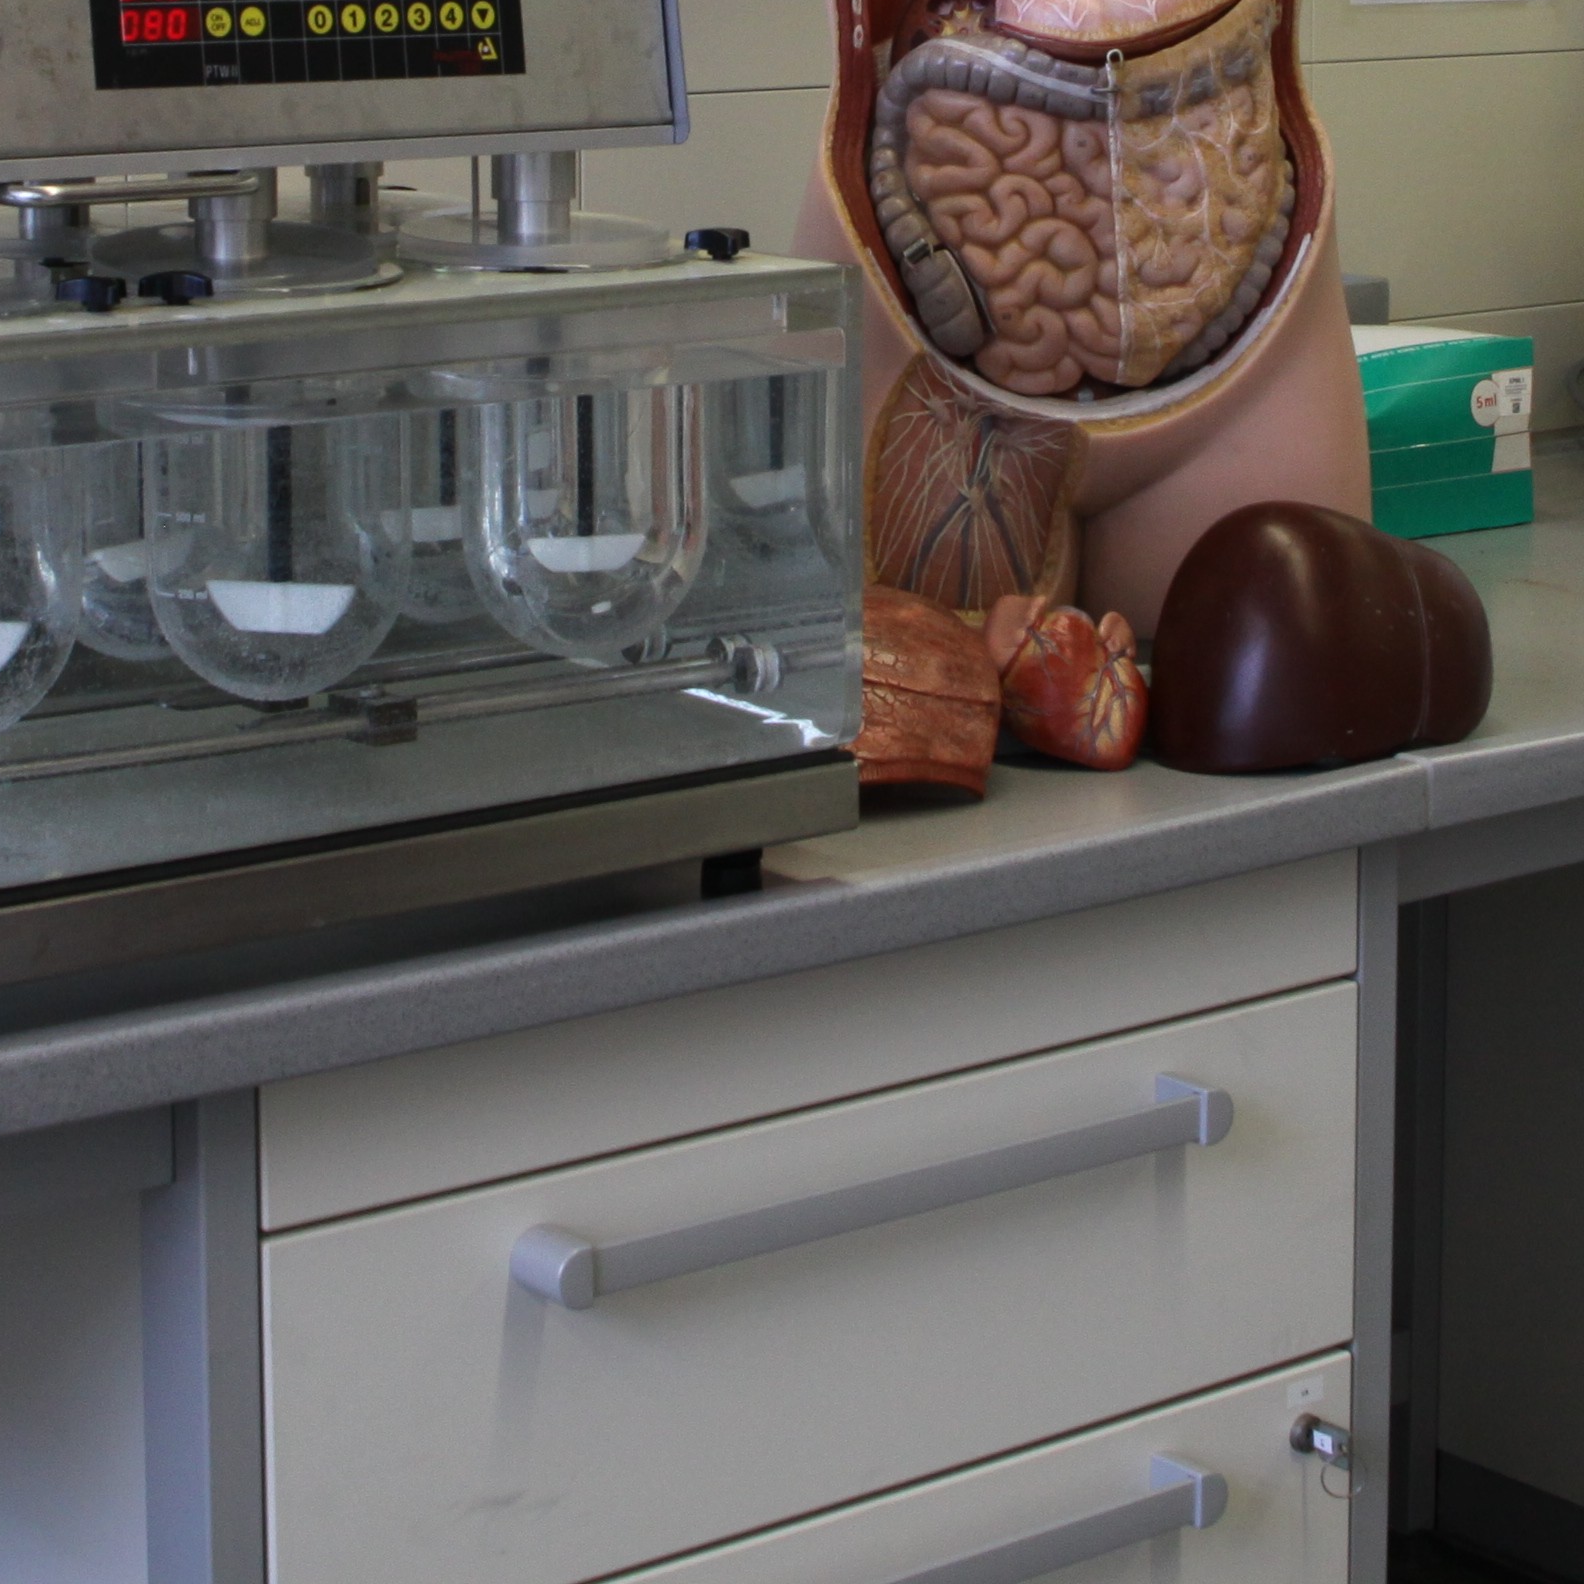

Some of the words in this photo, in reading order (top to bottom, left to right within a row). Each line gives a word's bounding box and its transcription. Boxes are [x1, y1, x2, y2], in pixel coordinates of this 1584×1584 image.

[210, 14, 224, 22] ON
[314, 10, 326, 30] 0
[348, 10, 358, 28] 1
[381, 8, 393, 28] 2
[414, 8, 425, 26] 3
[445, 6, 457, 25] 4
[212, 22, 225, 31] OFF
[1476, 396, 1484, 408] 5
[1484, 394, 1497, 408] ml
